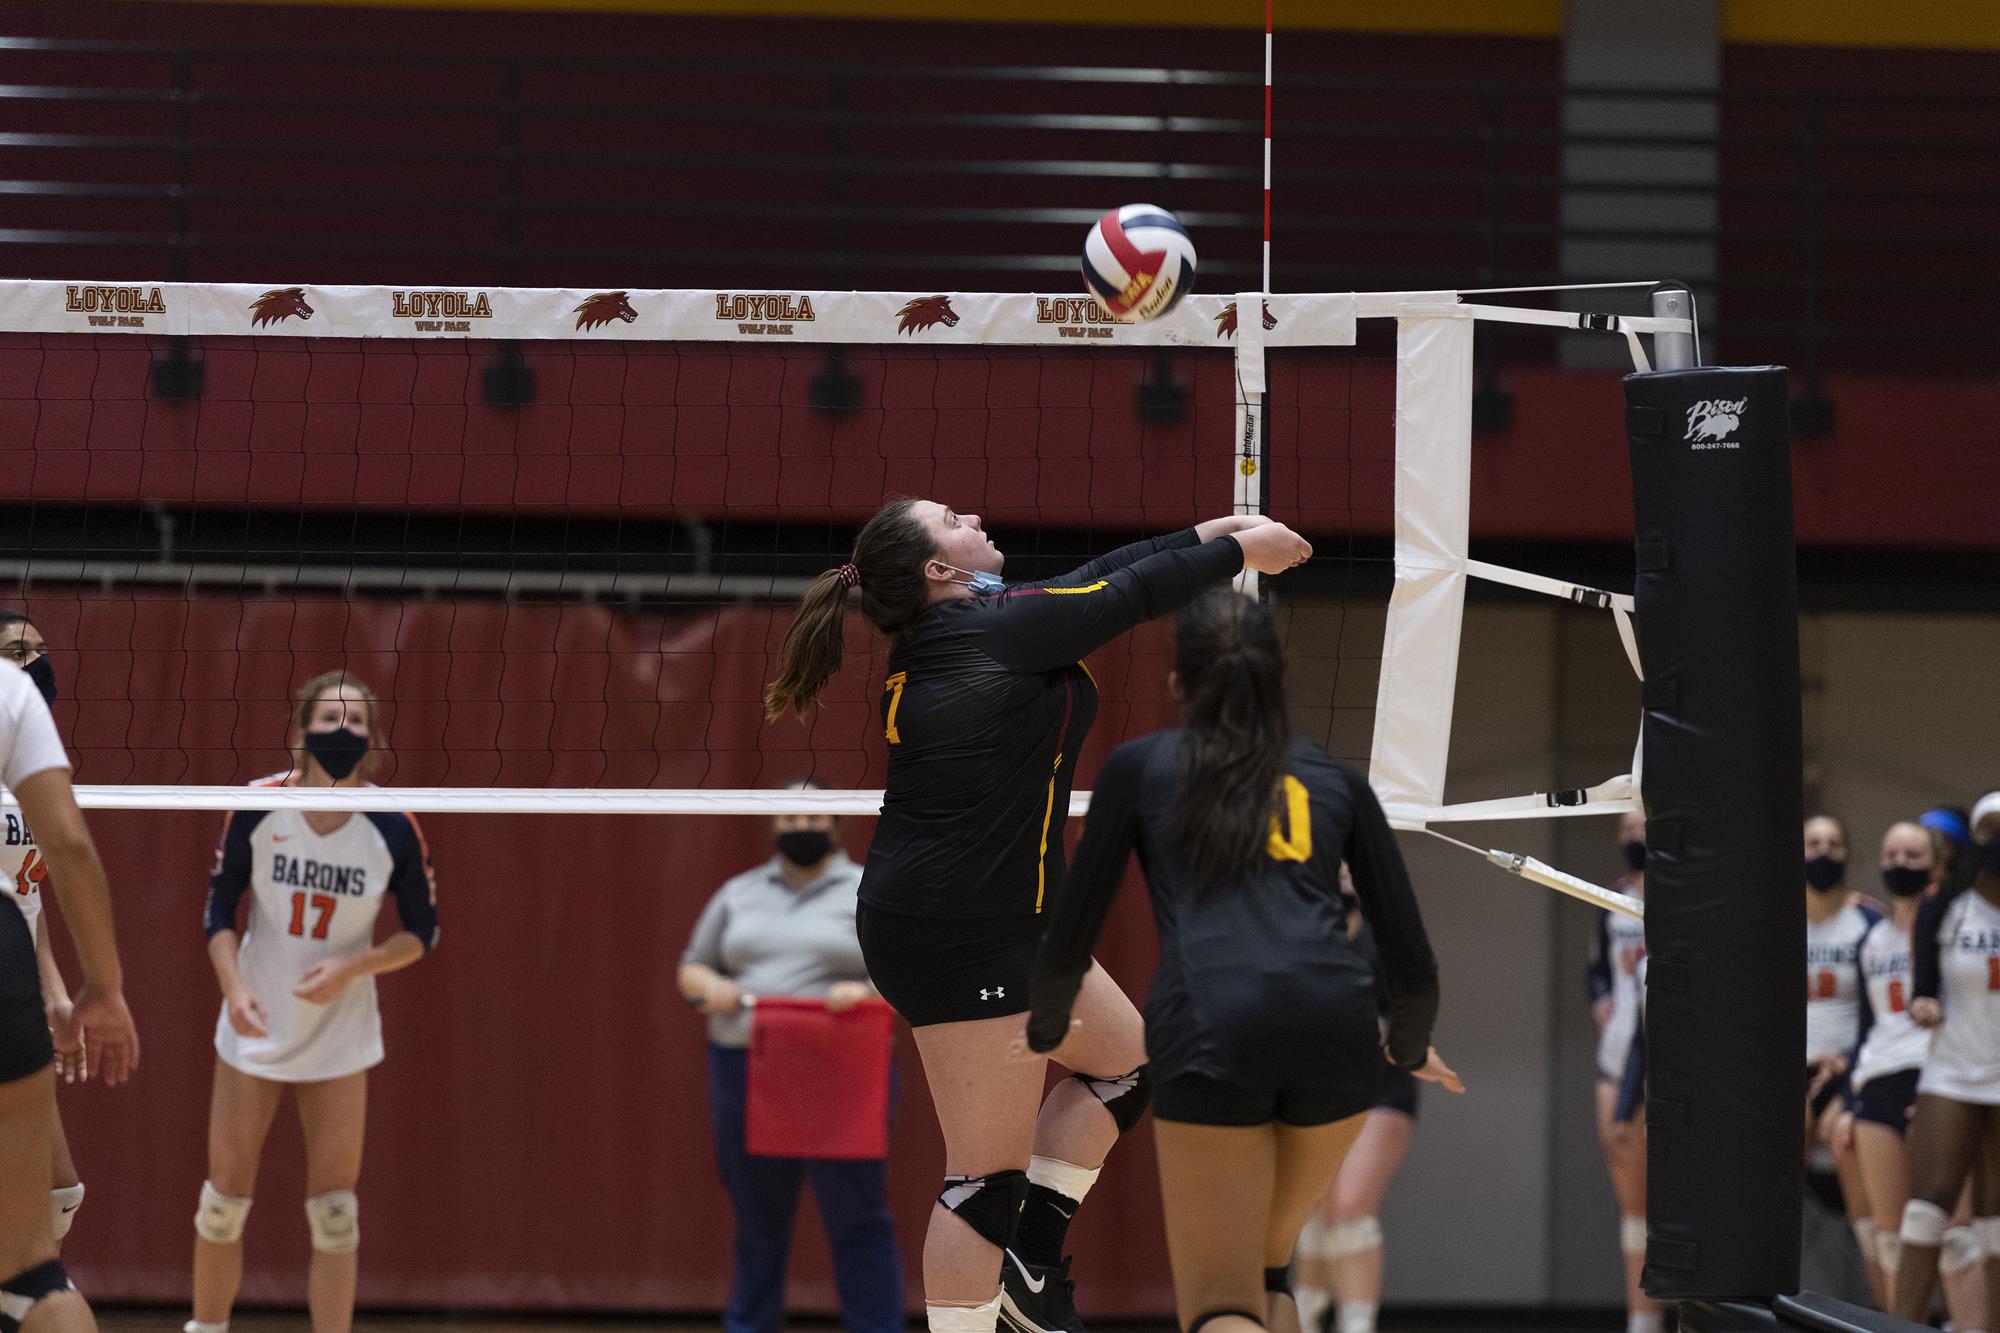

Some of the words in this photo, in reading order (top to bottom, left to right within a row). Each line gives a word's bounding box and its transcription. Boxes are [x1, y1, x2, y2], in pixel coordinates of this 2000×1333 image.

[66, 286, 166, 313] LOYOLA
[393, 292, 493, 318] LOYOLA
[716, 294, 815, 321] LOYOLA
[1037, 298, 1135, 324] LOYOL
[88, 315, 117, 326] WOLF
[117, 316, 145, 327] PACK
[415, 321, 442, 331] WOLF
[444, 321, 471, 332] PACK
[738, 324, 766, 334] WOLF
[767, 324, 794, 335] PACK
[1058, 327, 1086, 337] WOLF
[1087, 328, 1113, 338] PACK
[1683, 399, 1747, 440] Bison
[272, 854, 366, 897] BARONS
[288, 891, 337, 940] 17
